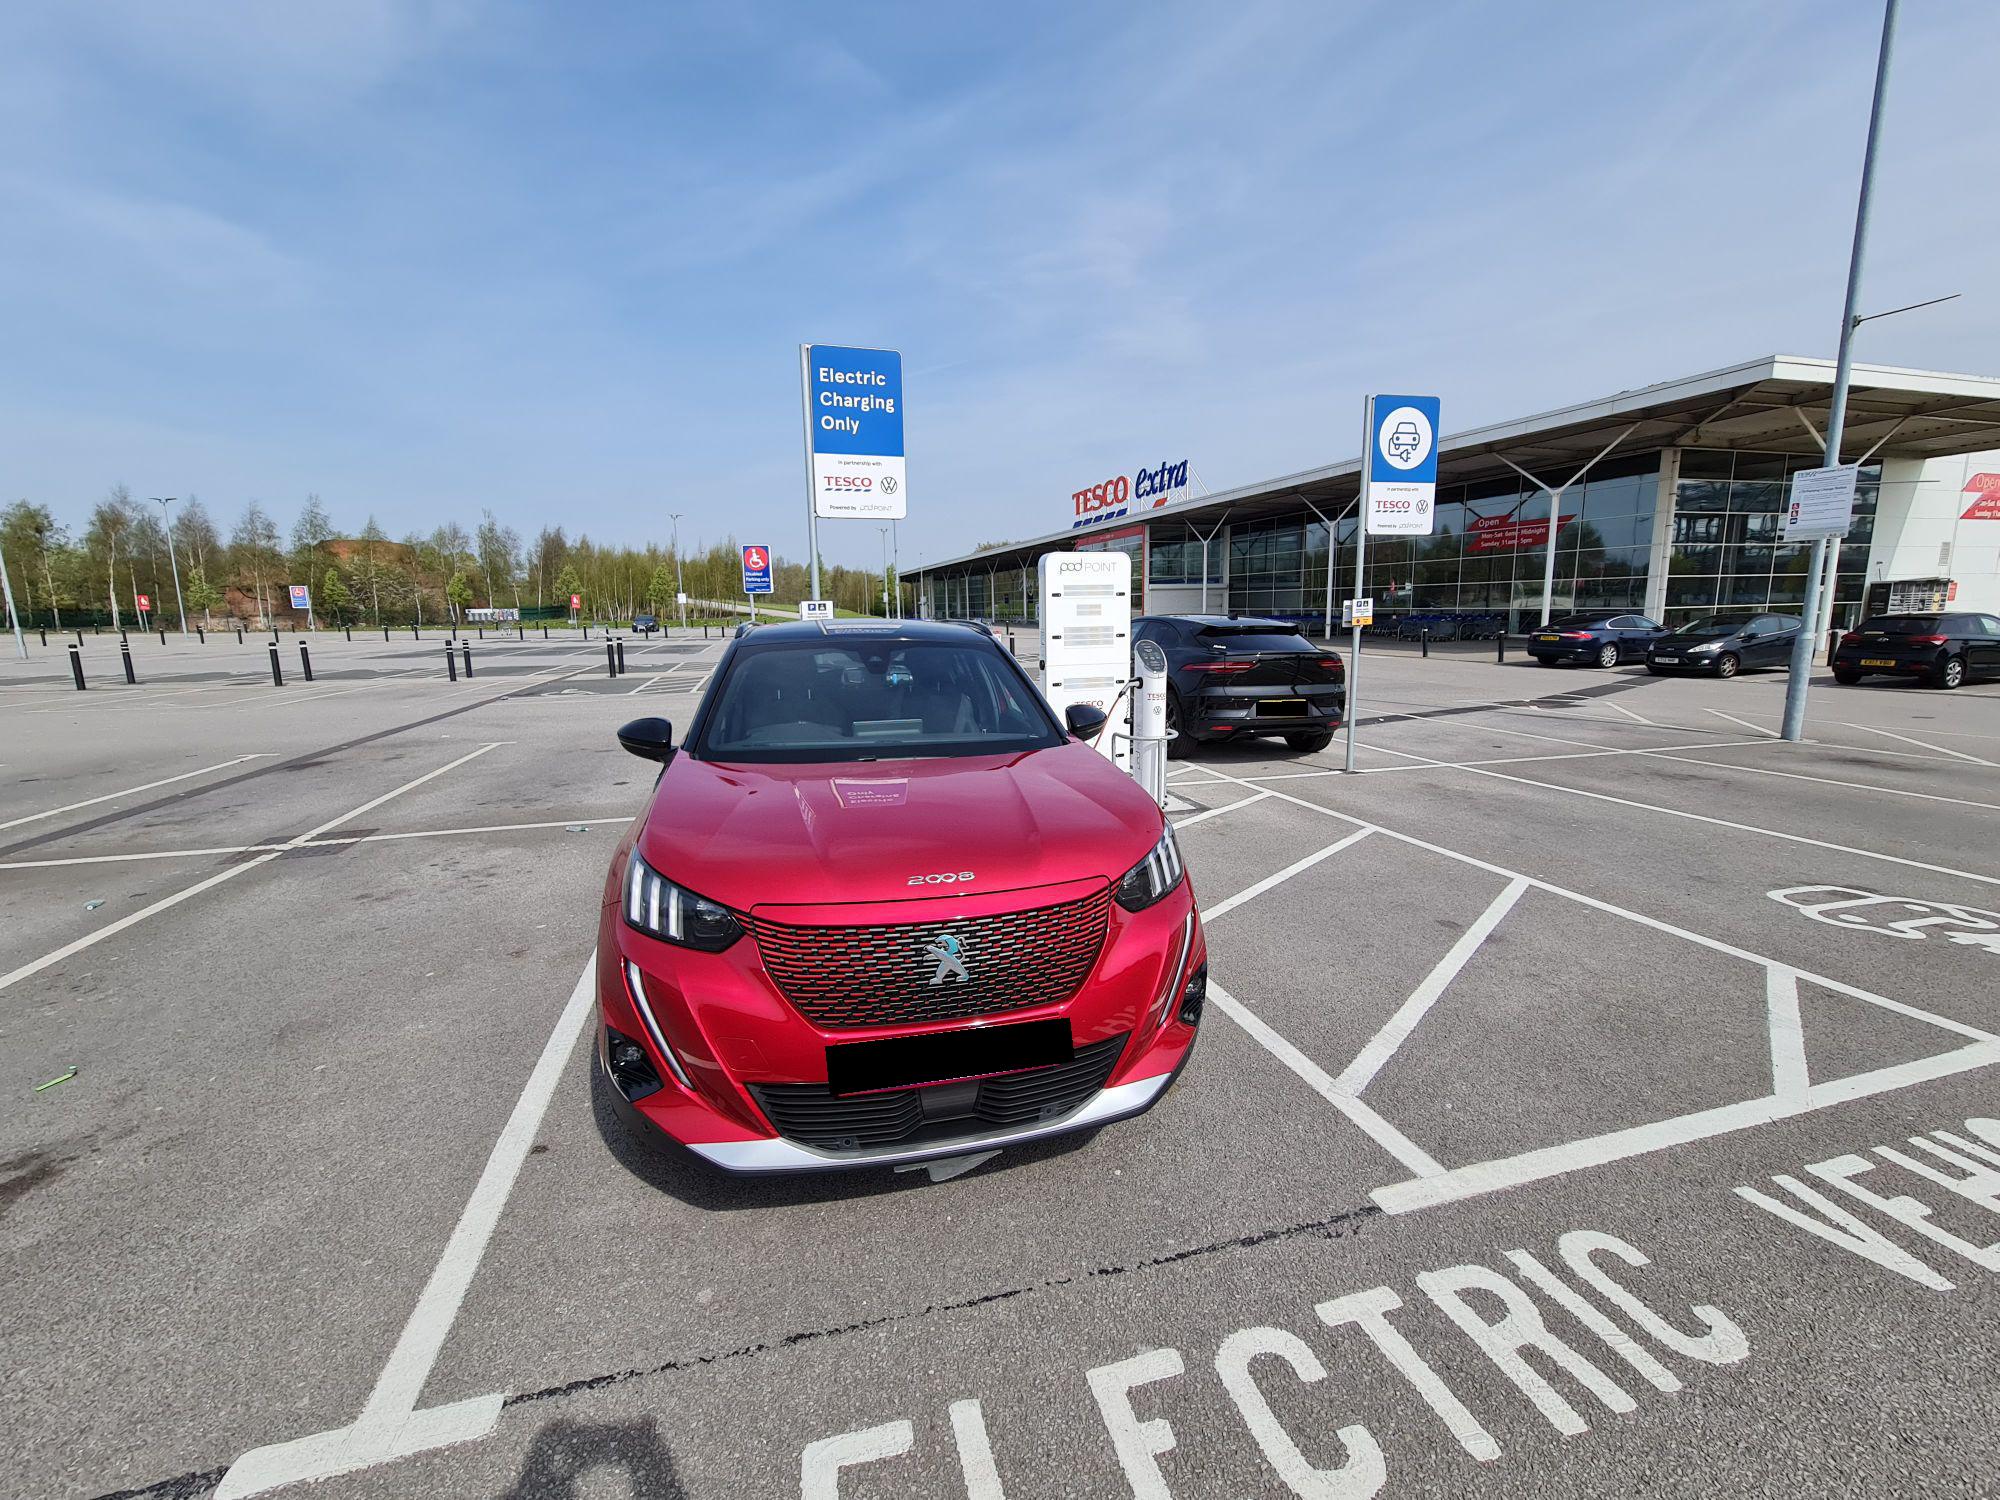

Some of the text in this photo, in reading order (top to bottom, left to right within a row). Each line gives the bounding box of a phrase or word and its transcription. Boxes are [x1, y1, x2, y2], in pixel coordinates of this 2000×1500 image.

[819, 367, 886, 386] Electric
[820, 391, 895, 413] Charging
[821, 415, 860, 435] Only
[824, 476, 872, 488] TESCO
[1072, 459, 1188, 515] TESCO extra
[1375, 500, 1411, 509] TESCO
[1478, 519, 1499, 528] Open
[1521, 527, 1546, 535] Midnight
[907, 871, 975, 885] 2008
